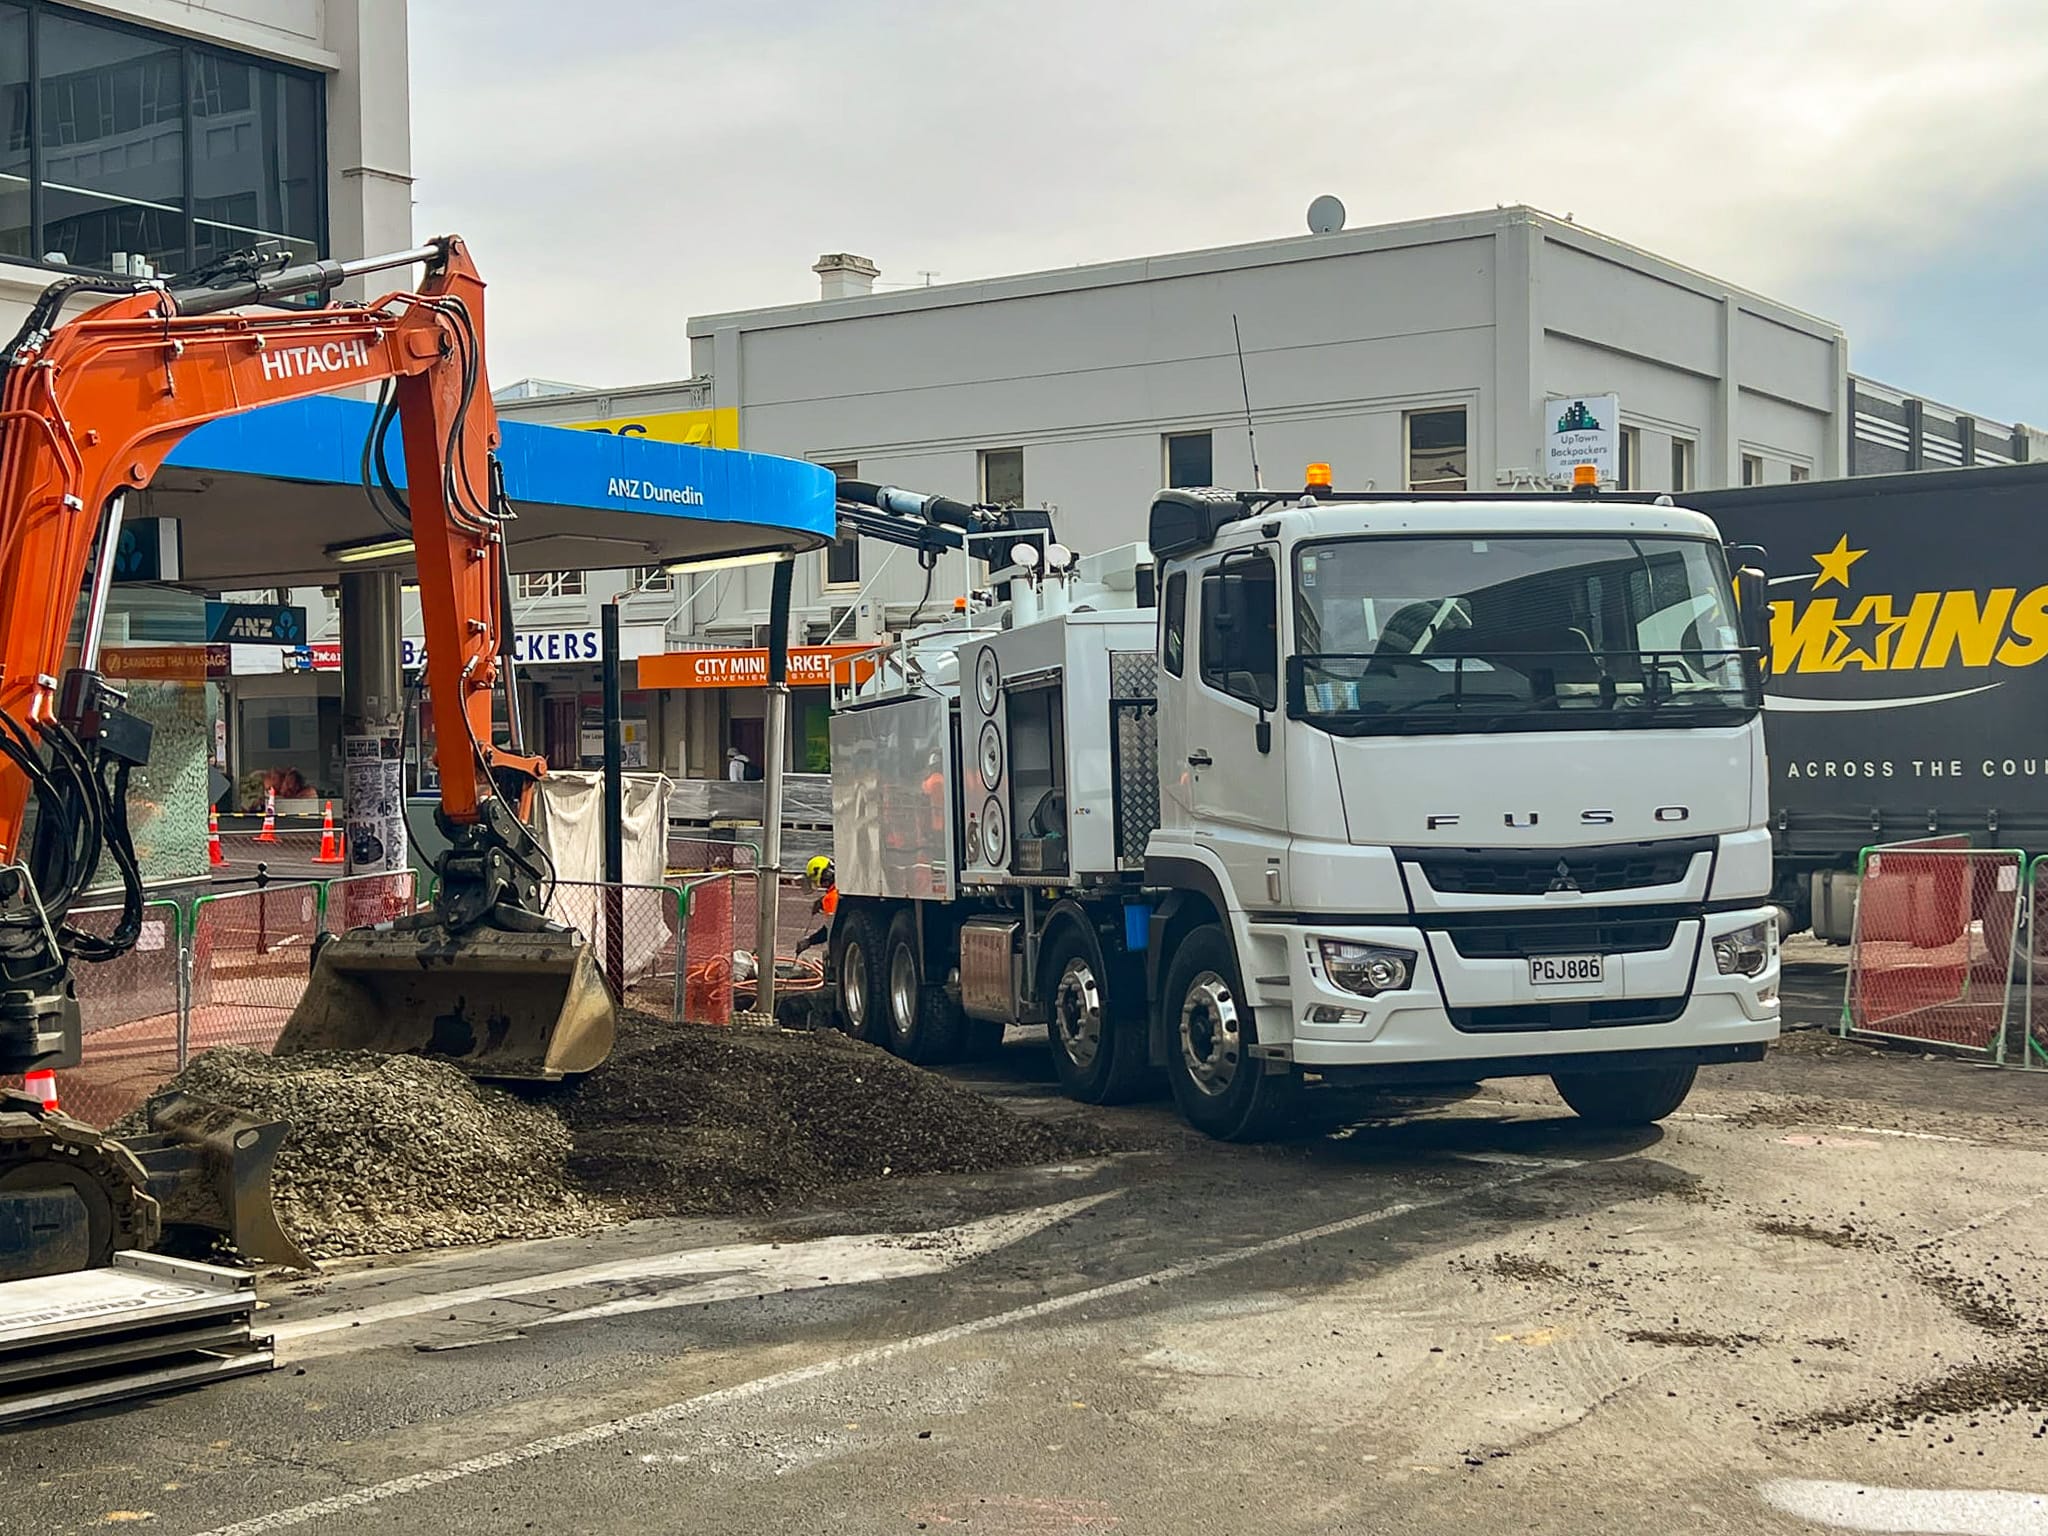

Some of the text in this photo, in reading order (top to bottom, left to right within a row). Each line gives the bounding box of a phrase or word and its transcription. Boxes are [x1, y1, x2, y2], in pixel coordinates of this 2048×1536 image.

[261, 339, 369, 381] HITACHI
[1560, 434, 1598, 444] UpTown
[1551, 445, 1607, 457] Backpackers
[608, 477, 704, 506] ANZ Dunedin
[229, 617, 273, 637] ANZ
[186, 654, 227, 666] MASSAGE
[695, 655, 832, 675] CITY MINI ARKET
[696, 674, 767, 683] CONVENIEN
[1788, 761, 1894, 778] ACROSS
[1912, 760, 1962, 777] THE
[1427, 805, 1689, 830] FUSO
[1532, 959, 1600, 980] PGJ806
